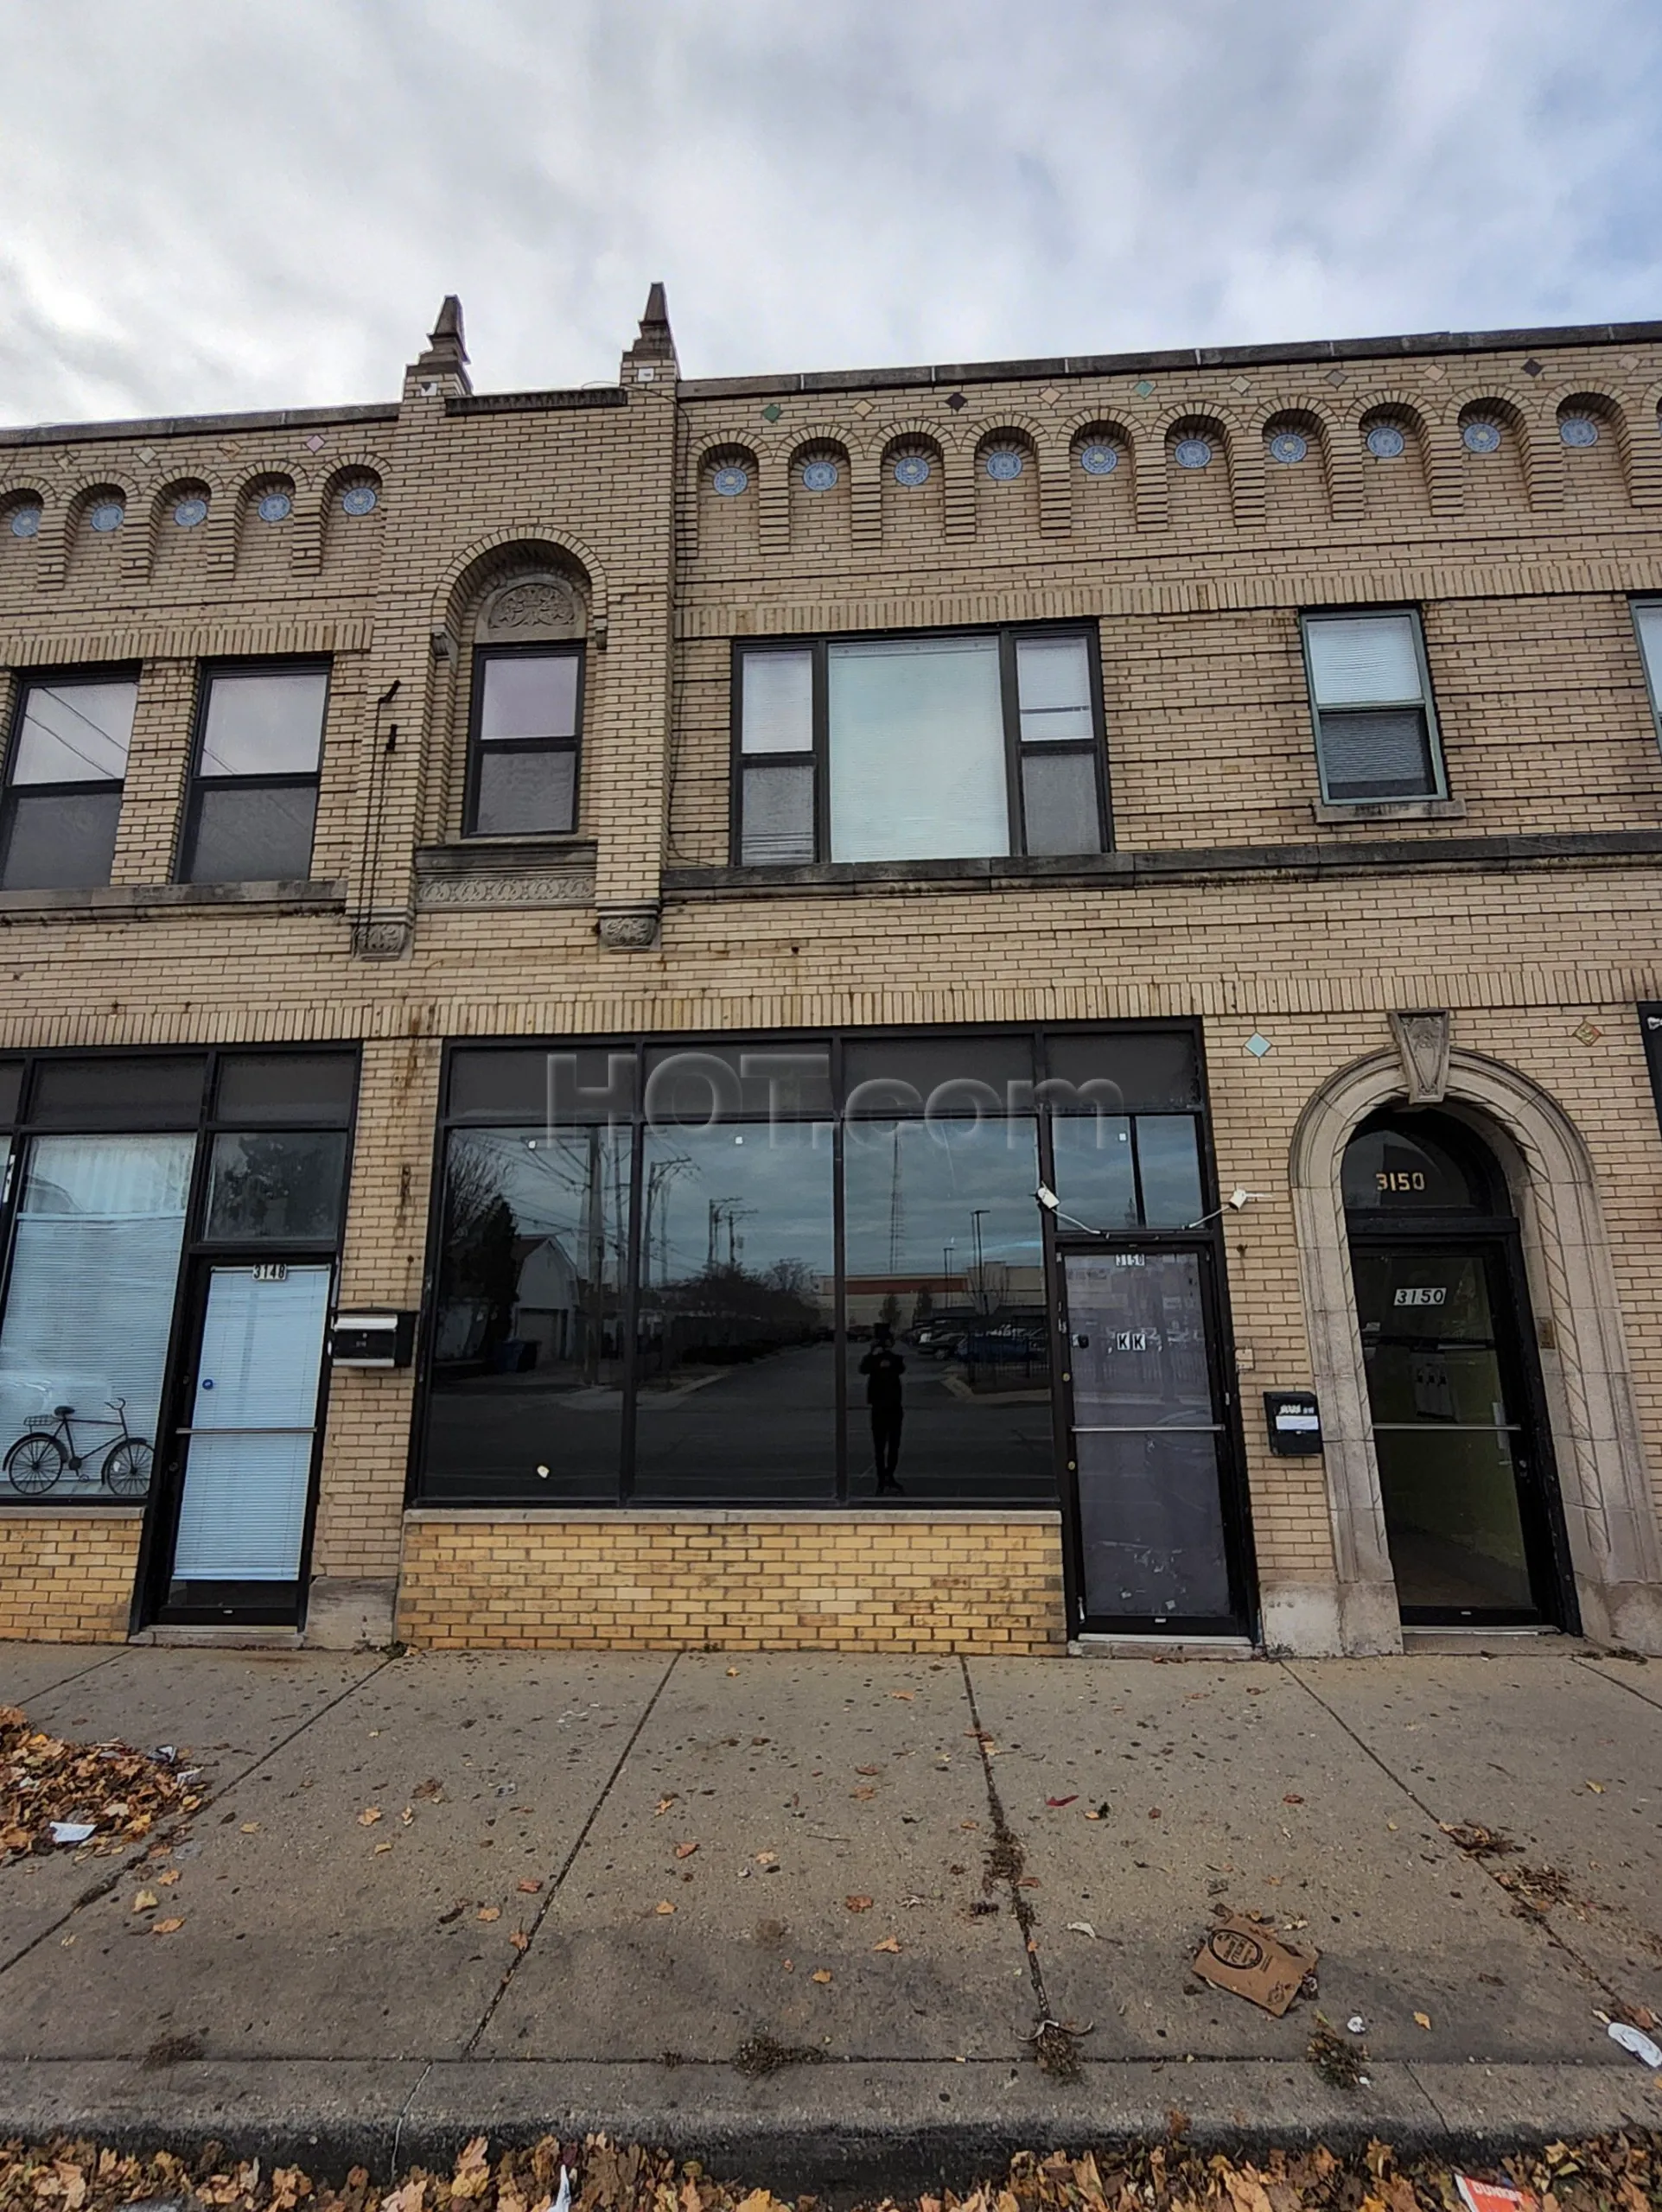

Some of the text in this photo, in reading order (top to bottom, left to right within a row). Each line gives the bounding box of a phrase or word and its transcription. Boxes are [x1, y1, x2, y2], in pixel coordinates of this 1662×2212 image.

[1375, 1172, 1425, 1191] 3150
[253, 1264, 284, 1279] 3148
[1397, 1289, 1444, 1304] 3150
